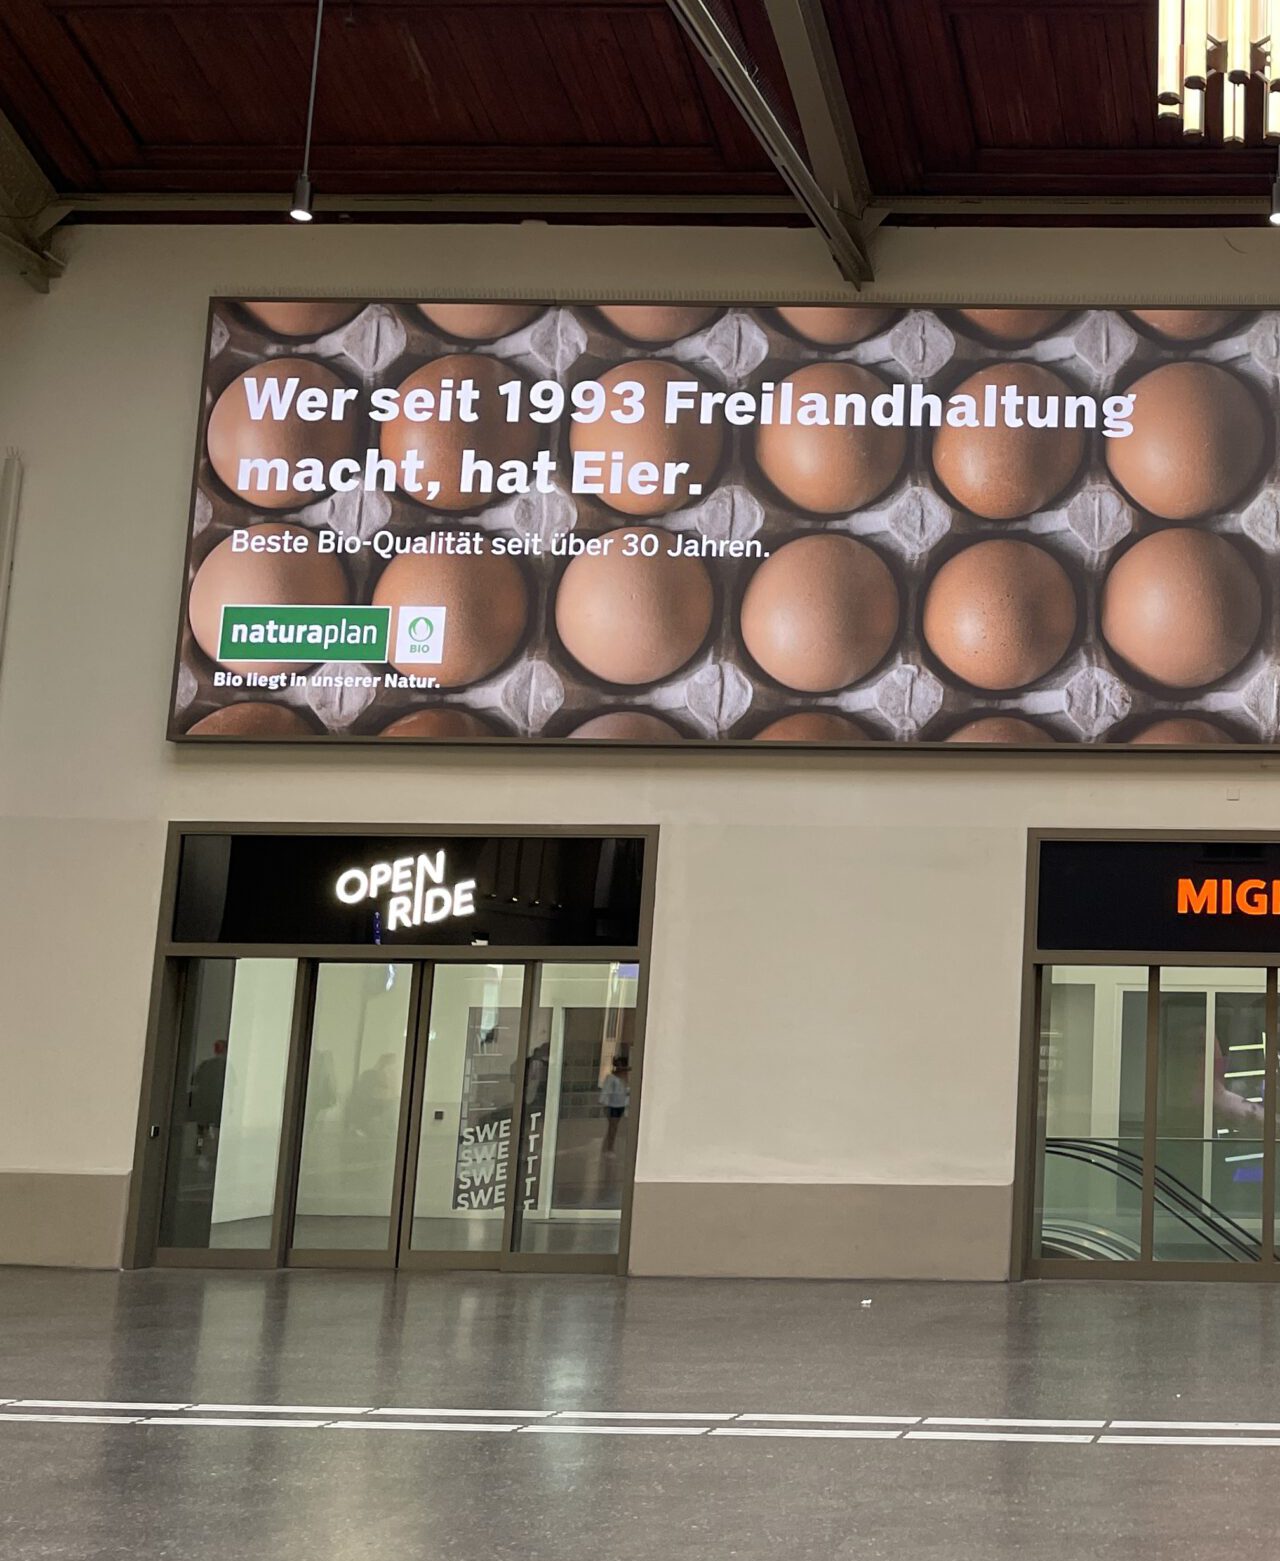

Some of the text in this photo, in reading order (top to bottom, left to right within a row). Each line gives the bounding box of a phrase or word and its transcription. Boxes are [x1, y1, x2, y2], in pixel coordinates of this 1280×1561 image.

[243, 377, 1137, 438] Wer seit 1993 Freilandhaltung
[236, 448, 703, 501] macht, hat Eier.
[231, 529, 770, 560] Beste Bio-Qualität seit über 30 Jahren.
[231, 617, 378, 650] naturaplan
[409, 643, 430, 654] BIO
[213, 671, 441, 691] Bio liegt in unserer Natur.
[335, 849, 445, 905] OPEN
[388, 879, 476, 931] RIDE
